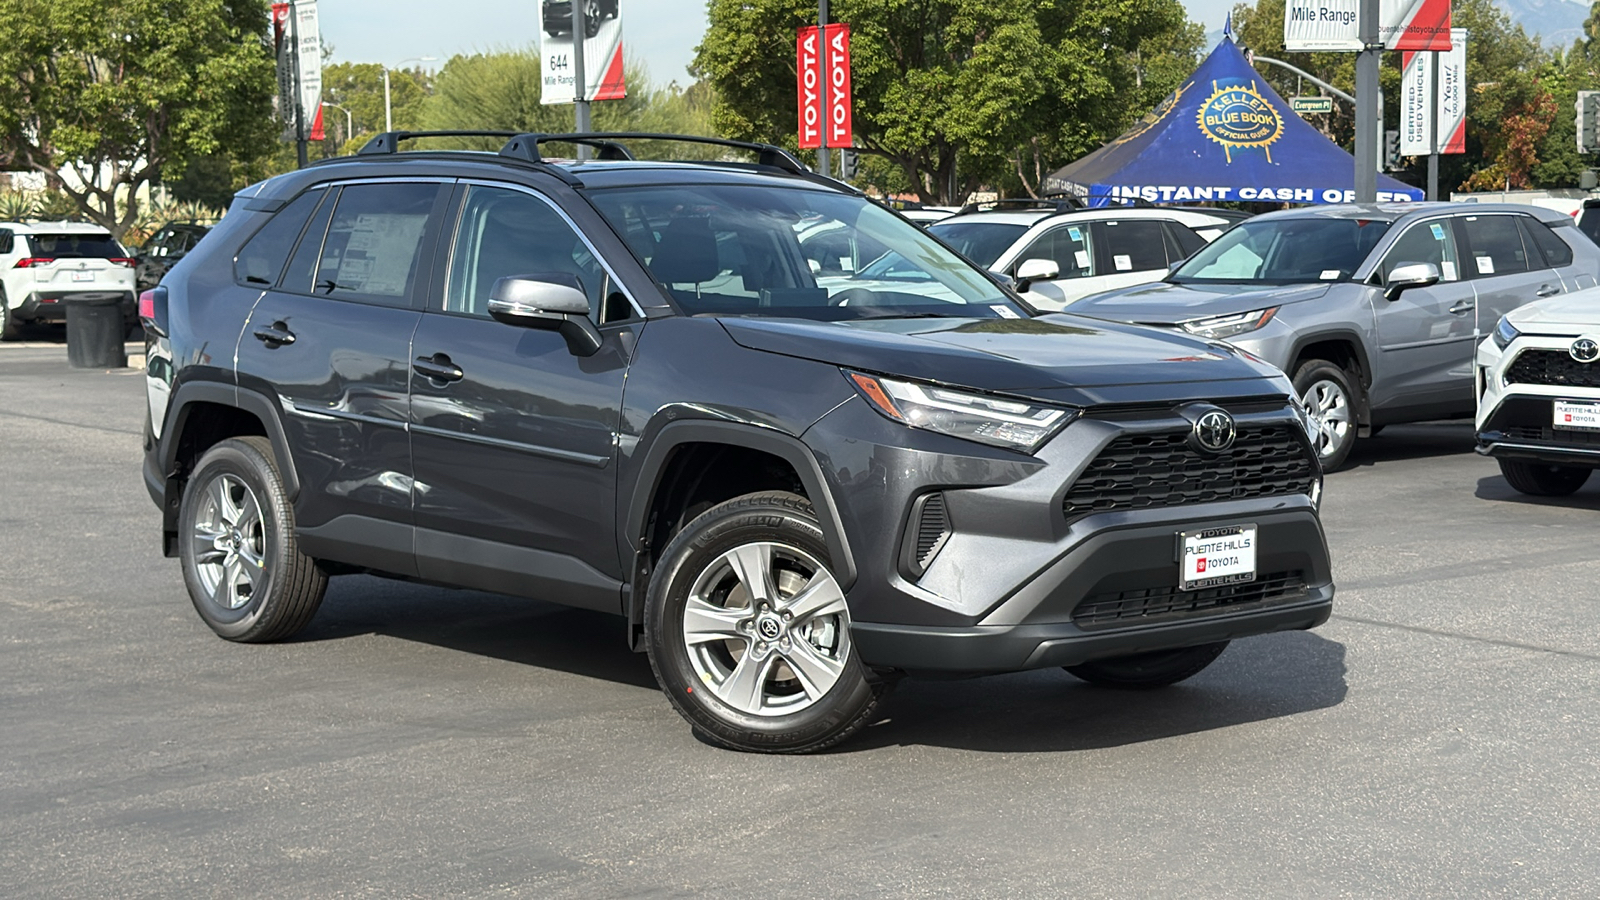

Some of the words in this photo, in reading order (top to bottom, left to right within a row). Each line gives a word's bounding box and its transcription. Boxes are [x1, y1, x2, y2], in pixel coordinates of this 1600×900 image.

[1291, 7, 1316, 22] Mile
[1320, 8, 1356, 26] Range
[550, 54, 568, 71] 644
[544, 76, 556, 86] Mile
[558, 75, 576, 87] Rang
[804, 34, 817, 142] TOYOTA
[832, 31, 846, 141] TOYOTA
[1416, 57, 1424, 110] VEHICLES
[1444, 65, 1452, 103] Year/
[1211, 93, 1268, 113] KELLEY
[1295, 101, 1322, 111] Evergreen
[1206, 112, 1240, 126] BLUE
[1241, 112, 1275, 126] BOOK
[1215, 126, 1250, 140] OFFICIAL
[1250, 126, 1270, 139] GUIDE
[1112, 185, 1232, 205] INSTANT
[1238, 187, 1314, 201] CASH
[1322, 189, 1412, 203] OFER
[1202, 527, 1240, 538] TOYOTA
[1185, 541, 1223, 555] PUENTE
[1224, 538, 1251, 551] HILLS
[1208, 556, 1239, 568] TOYOTA
[1186, 577, 1222, 589] PUENTE
[1224, 572, 1252, 583] HILLS
